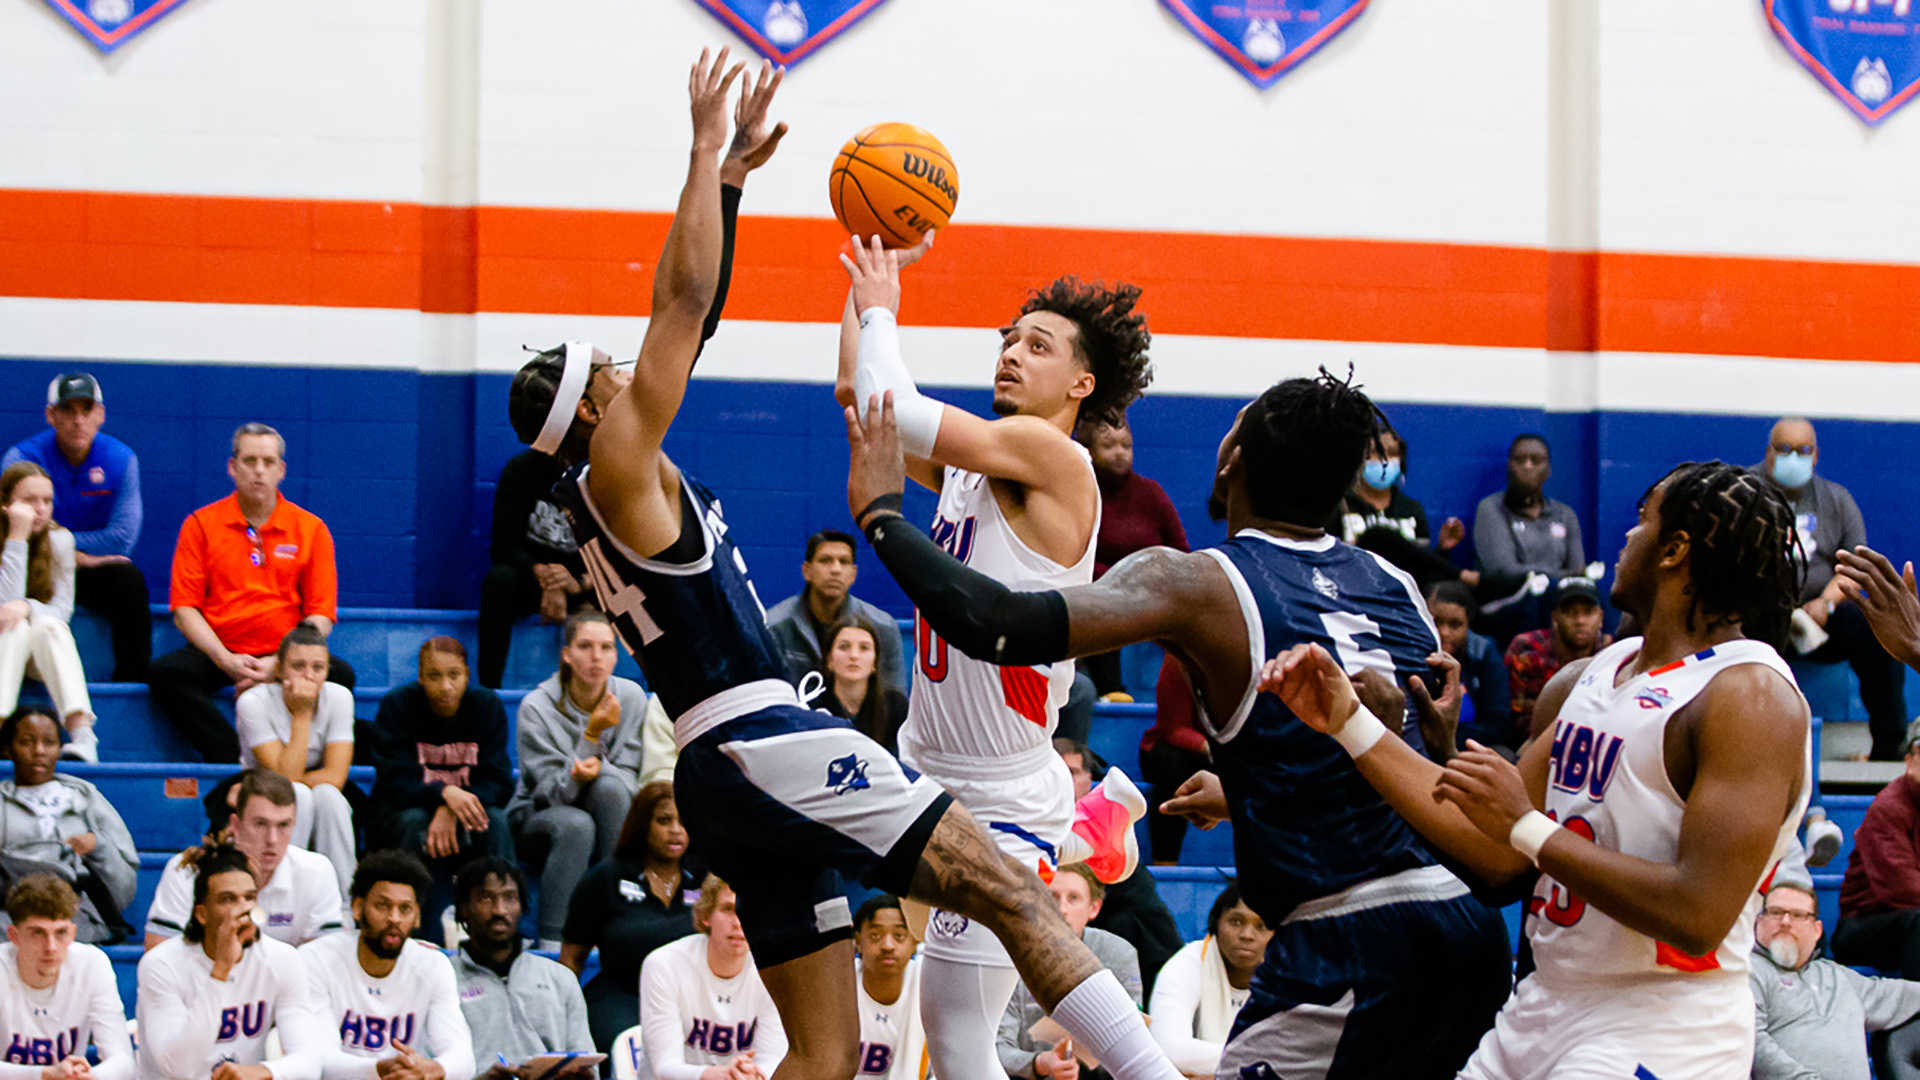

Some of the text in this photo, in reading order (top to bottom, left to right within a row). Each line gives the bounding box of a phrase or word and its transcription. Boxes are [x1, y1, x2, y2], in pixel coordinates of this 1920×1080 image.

[903, 152, 958, 206] Wilso
[579, 536, 665, 656] 4
[1319, 611, 1397, 688] 5
[1550, 719, 1625, 803] HBU
[5, 1025, 79, 1066] HBU
[339, 1009, 415, 1051] HBU
[685, 1016, 758, 1057] HBU
